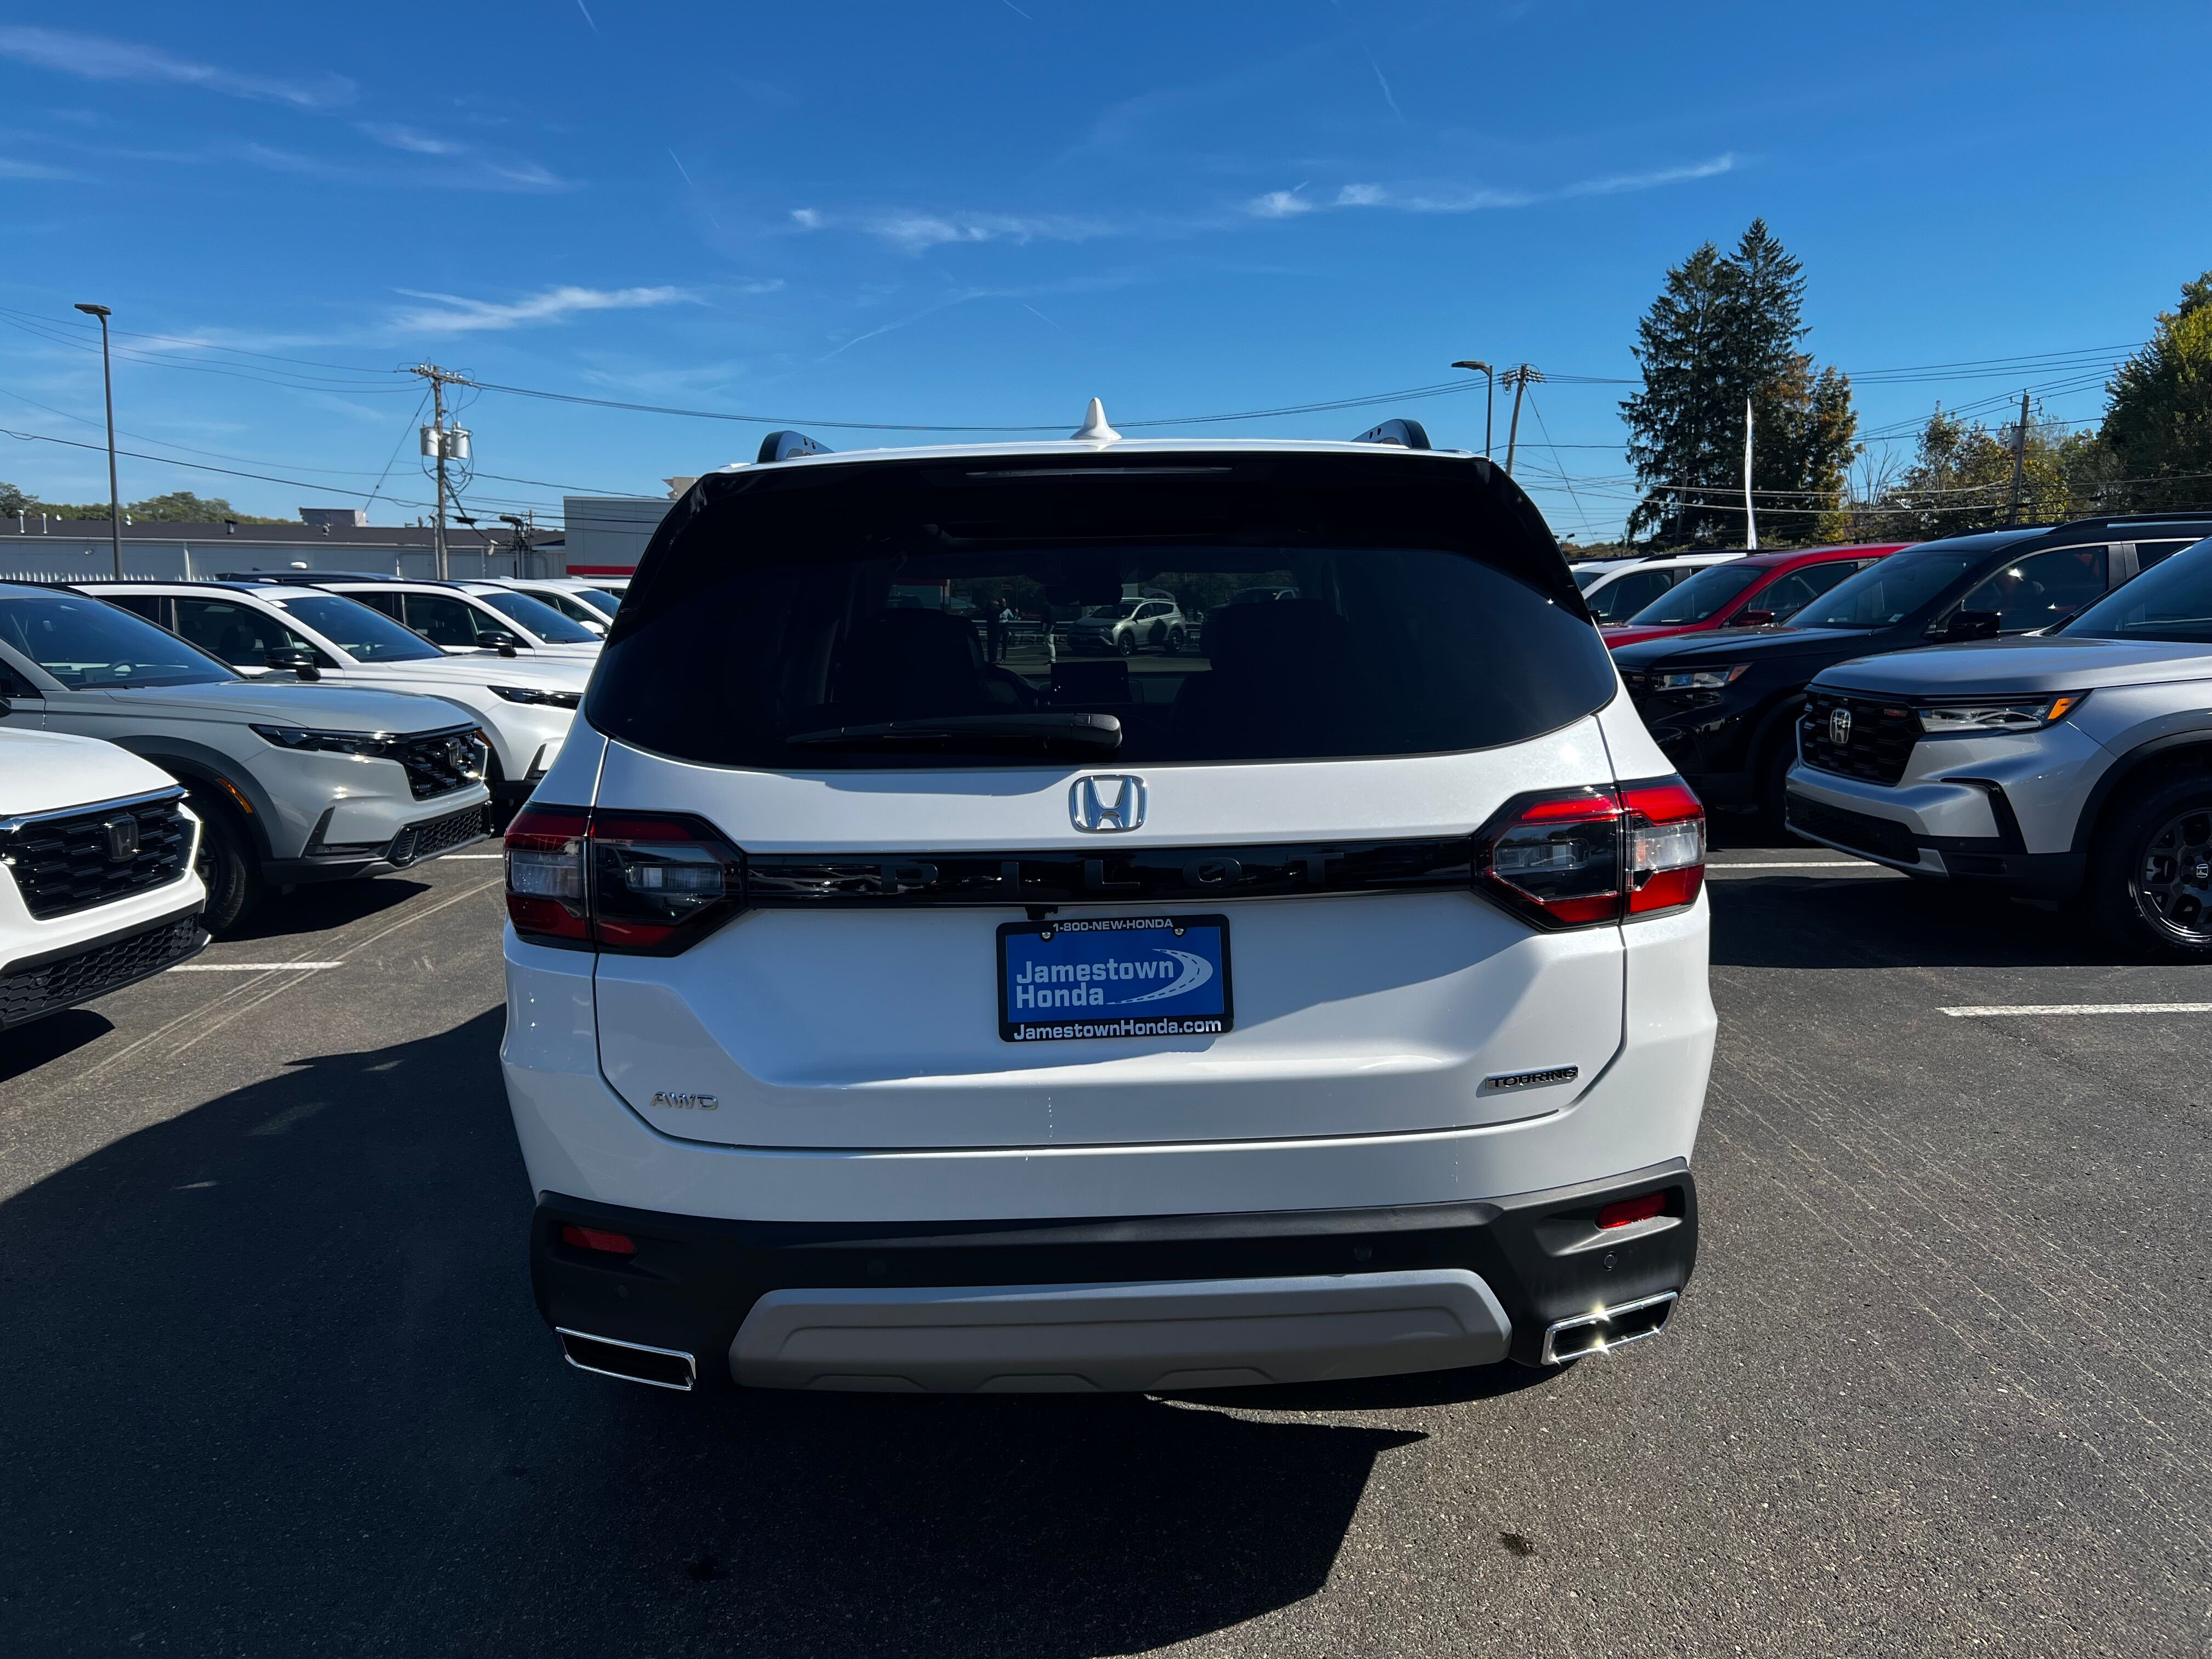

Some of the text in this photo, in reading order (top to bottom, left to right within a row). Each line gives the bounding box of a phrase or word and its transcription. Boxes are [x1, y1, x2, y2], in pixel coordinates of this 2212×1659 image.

[881, 852, 1344, 894] PILOT
[1053, 918, 1173, 932] 1-800-NEW-HONDA
[1017, 958, 1174, 984] Jamestown
[1017, 982, 1104, 1008] Honda
[1014, 1018, 1221, 1040] JamestownHonda.com
[1488, 1069, 1577, 1087] TOURING
[650, 1091, 719, 1110] AWD
